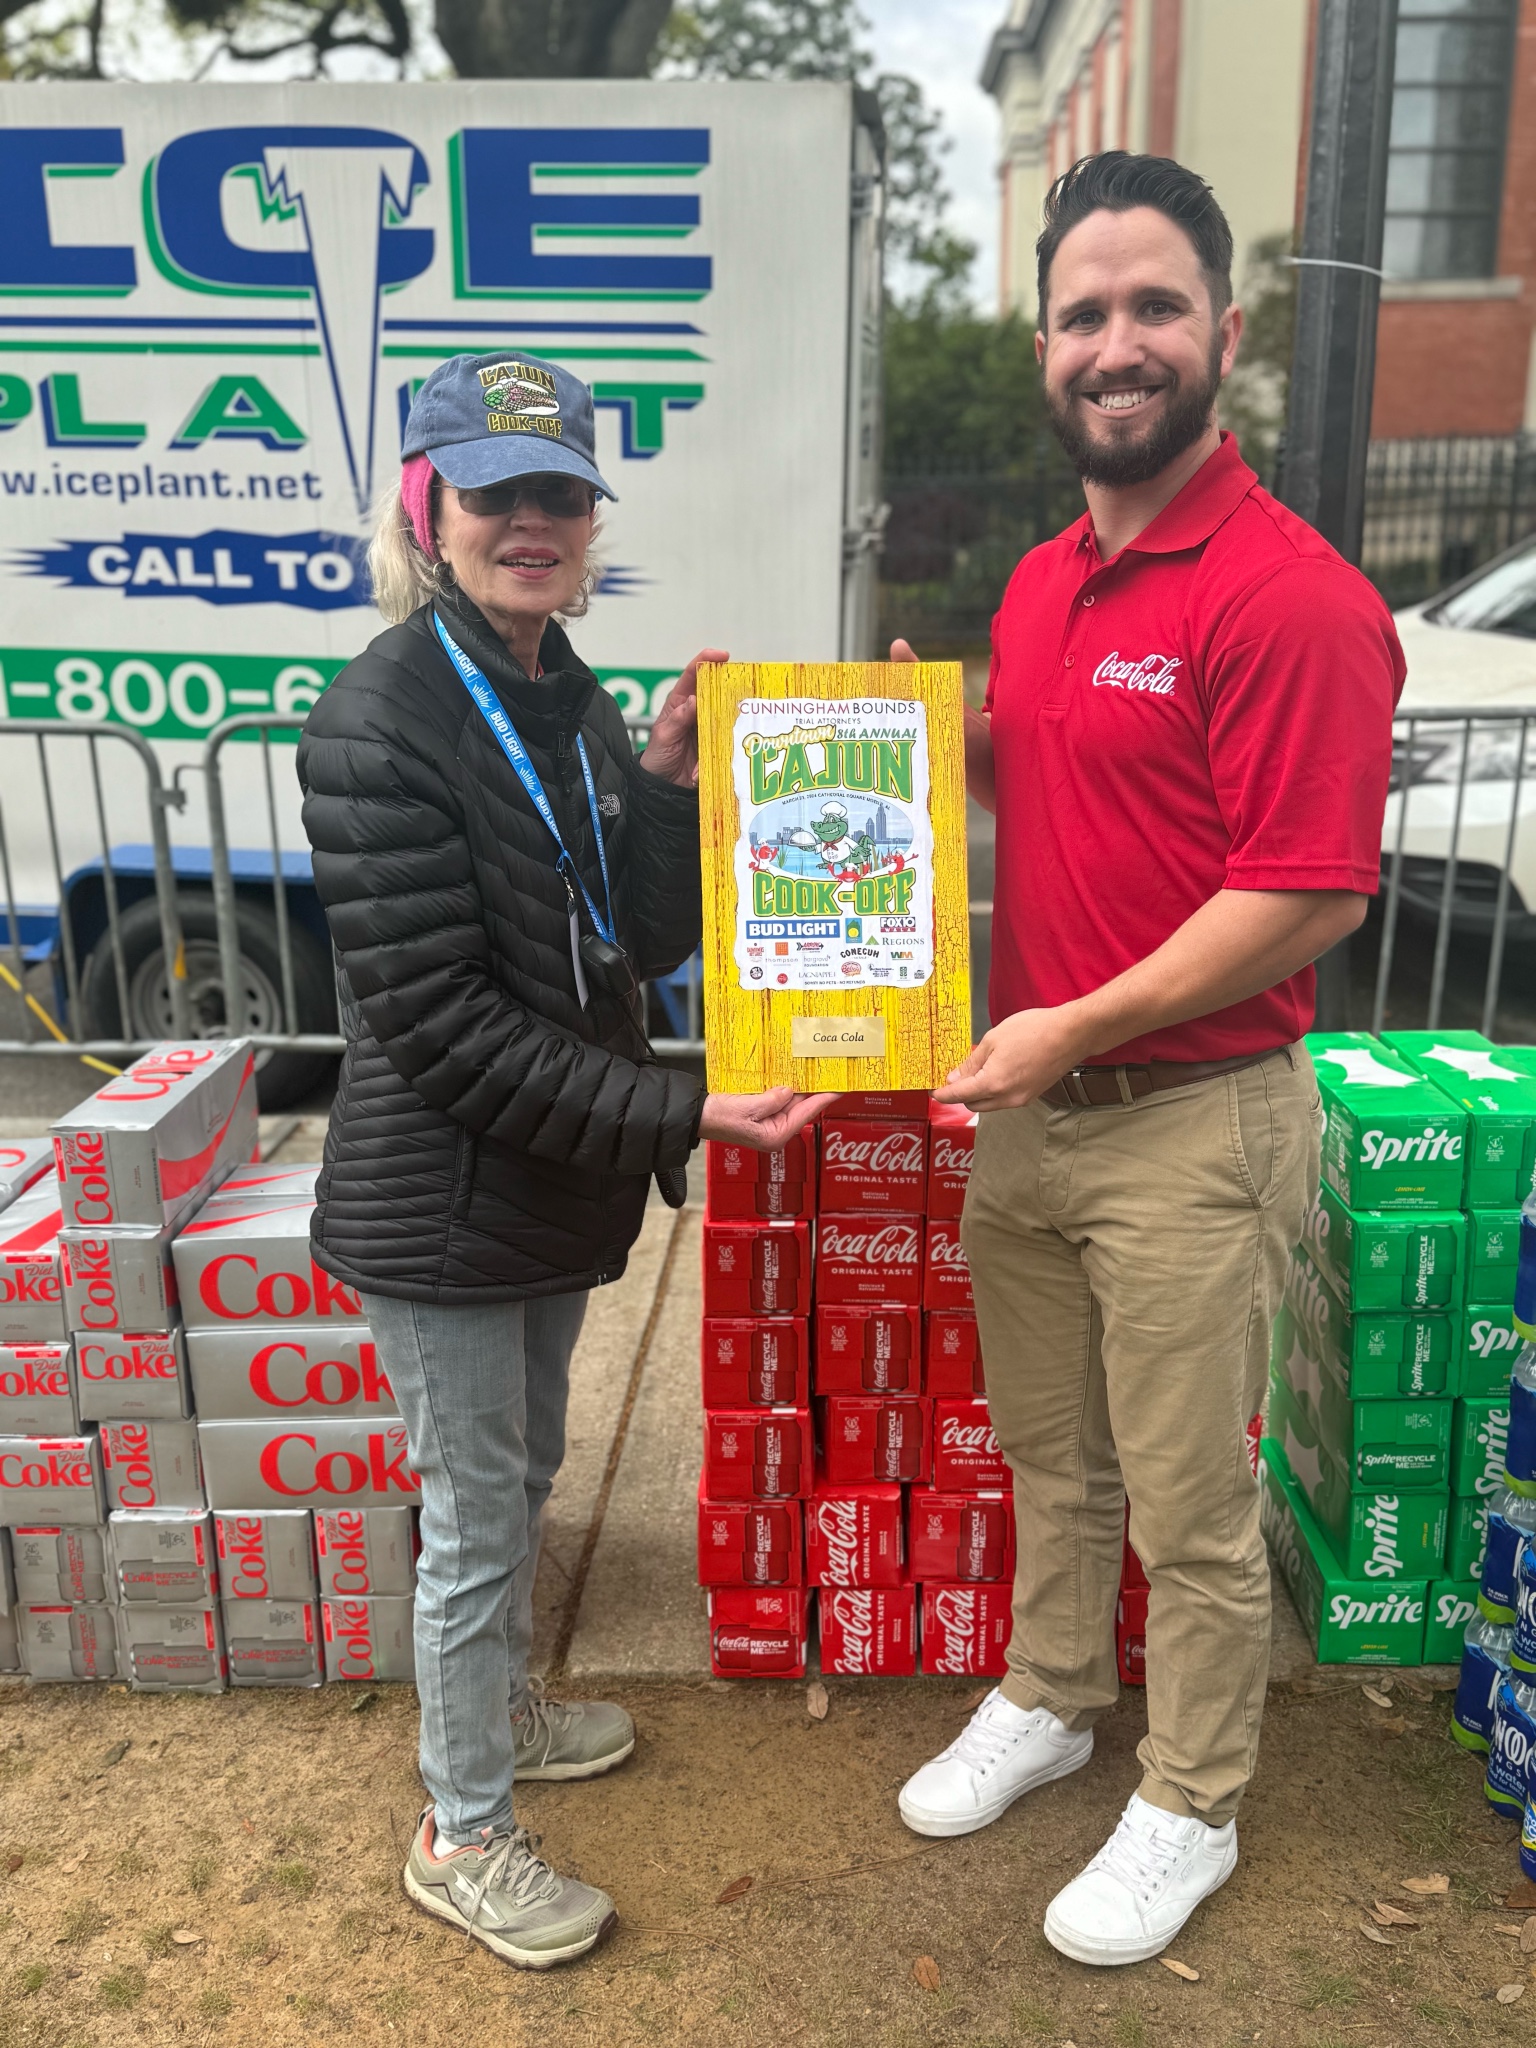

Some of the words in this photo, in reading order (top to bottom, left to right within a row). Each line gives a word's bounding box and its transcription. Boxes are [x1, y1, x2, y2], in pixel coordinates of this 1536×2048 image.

[477, 362, 557, 394] CAJUN
[487, 412, 563, 438] COOK-OFF
[88, 544, 254, 590] CALL
[264, 551, 355, 593] TO
[1092, 651, 1184, 695] Coca-Cola
[490, 710, 509, 733] BUD
[502, 729, 526, 762] LIGHT
[743, 726, 836, 756] Downtown
[837, 728, 856, 740] 8th
[859, 728, 918, 740] ANNUAL
[750, 740, 916, 805] CAJUN
[536, 794, 550, 815] BUD
[752, 868, 916, 916] COOK-OFF
[749, 923, 785, 937] BUD
[786, 923, 838, 936] LIGHT
[840, 947, 880, 959] CONECUH
[890, 951, 914, 959] WM
[813, 1032, 838, 1042] Coca
[840, 1032, 865, 1042] Cola
[1359, 1127, 1463, 1170] Sprite
[70, 1132, 114, 1225] Coke
[834, 1174, 884, 1185] ORIGINAL
[887, 1176, 918, 1184] TASTE
[24, 1263, 54, 1276] Diet
[764, 1239, 772, 1280] RECYCLE
[1420, 1235, 1428, 1275] RECYCLE
[1427, 1259, 1435, 1275] ME
[75, 1238, 119, 1330] Coke
[772, 1263, 779, 1280] ME
[831, 1268, 879, 1277] ORIGINAL
[882, 1268, 914, 1277] TASTE
[1415, 1274, 1428, 1305] Sprite
[763, 1332, 771, 1372] RECYCLE
[876, 1320, 884, 1359] RECYCLE
[884, 1344, 891, 1359] ME
[1415, 1323, 1424, 1363] RECYCLE
[34, 1358, 62, 1371] Diet
[79, 1344, 178, 1381] Coke
[770, 1356, 778, 1372] ME
[1411, 1361, 1422, 1391] Sprite
[888, 1410, 896, 1449] RECYCLE
[896, 1433, 903, 1449] ME
[0, 1453, 93, 1489] Coke
[115, 1424, 156, 1508] Coke
[774, 1450, 781, 1465] ME
[950, 1458, 998, 1466] ORIGINAL
[1363, 1453, 1398, 1467] Sprite
[1395, 1454, 1437, 1463] RECYCLE
[1395, 1461, 1410, 1469] ME
[756, 1514, 764, 1552] RECYCLE
[764, 1537, 771, 1552] ME
[971, 1511, 979, 1548] RECYCLE
[979, 1533, 987, 1549] ME
[1364, 1494, 1404, 1578] Sprite
[229, 1516, 268, 1598] Coke
[331, 1511, 369, 1595] Coke
[123, 1572, 154, 1584] Coke
[153, 1571, 199, 1580] RECYCLE
[877, 1593, 885, 1622] TASTE
[1328, 1593, 1424, 1630] Sprite
[337, 1600, 375, 1680] Coke
[750, 1640, 789, 1648] RECYCLE
[751, 1647, 766, 1655] ME
